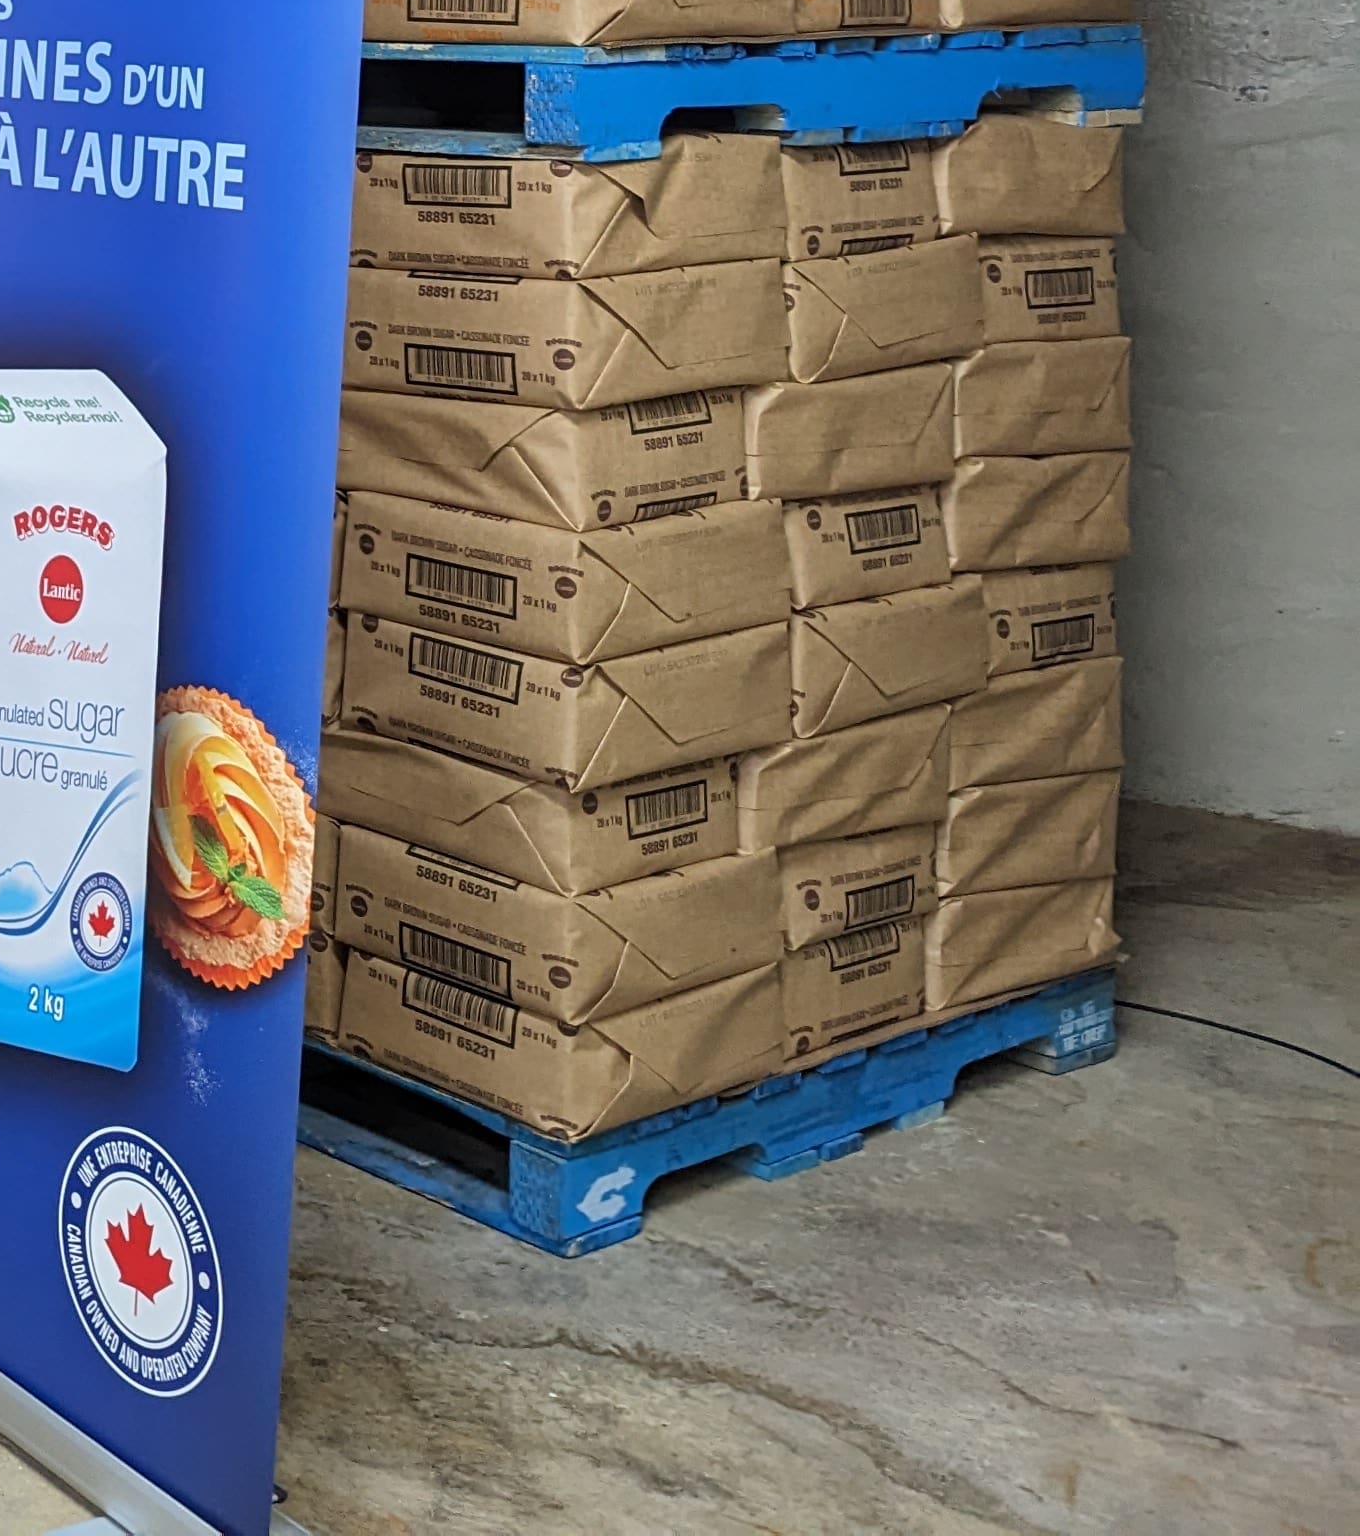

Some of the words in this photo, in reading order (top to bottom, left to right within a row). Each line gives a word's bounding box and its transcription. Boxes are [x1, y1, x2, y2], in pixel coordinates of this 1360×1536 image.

[123, 64, 204, 110] D'UN
[35, 126, 246, 211] L'AUTRE
[542, 182, 552, 193] kg
[418, 211, 454, 223] 58891
[459, 213, 496, 226] 65231
[418, 285, 455, 298] 58891
[460, 287, 499, 302] 65231
[14, 396, 69, 410] Recycle
[74, 396, 102, 408] me!
[24, 411, 123, 424] Recyclez-moi!
[13, 505, 115, 551] ROGERS
[42, 578, 81, 602] Lantic
[419, 604, 456, 623] 58891
[462, 615, 500, 634] 65231
[9, 633, 56, 657] Natural
[63, 640, 109, 664] Naturel
[420, 684, 456, 705] 58891
[461, 698, 500, 718] 65231
[48, 698, 125, 744] sugar
[61, 769, 108, 791] granulé
[641, 839, 669, 856] 58891
[673, 832, 698, 848] 65231
[416, 864, 454, 888] 58891
[458, 879, 499, 903] 65231
[29, 986, 39, 1011] 2
[44, 988, 64, 1021] kg
[415, 1020, 452, 1044] 58891
[456, 1037, 496, 1061] 65231
[77, 1155, 95, 1188] UNE
[95, 1140, 152, 1173] ENTREPRISE
[154, 1162, 207, 1254] CANADIENNE
[66, 1223, 89, 1301] CANADIAN
[86, 1298, 119, 1354] OWNED
[119, 1346, 140, 1374] AND
[141, 1356, 186, 1382] OPERATED
[182, 1304, 213, 1367] COMPANY
